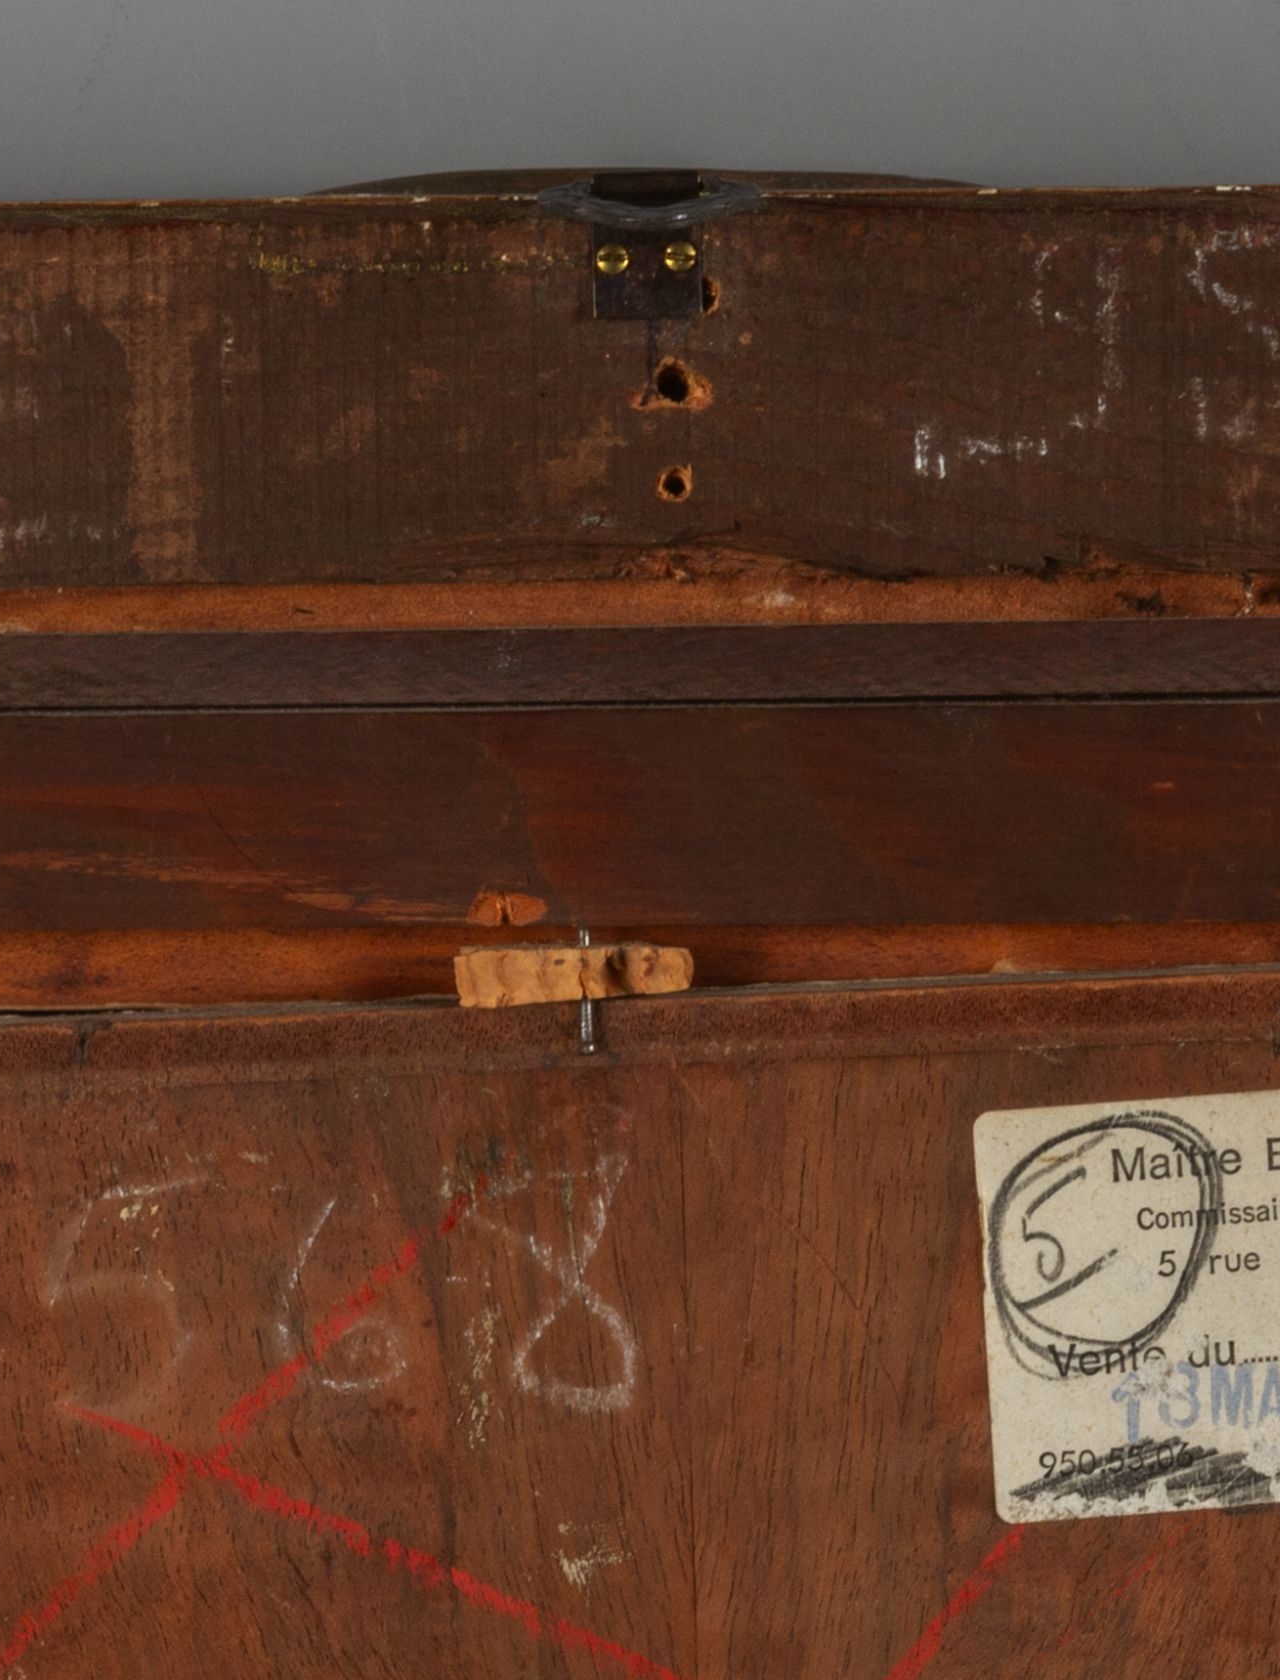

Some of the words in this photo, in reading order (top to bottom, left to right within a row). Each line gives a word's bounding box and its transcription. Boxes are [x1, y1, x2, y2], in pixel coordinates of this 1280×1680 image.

[1111, 1141, 1242, 1182] Maître
[1209, 1251, 1261, 1274] rue
[1048, 1340, 1166, 1377] Vente
